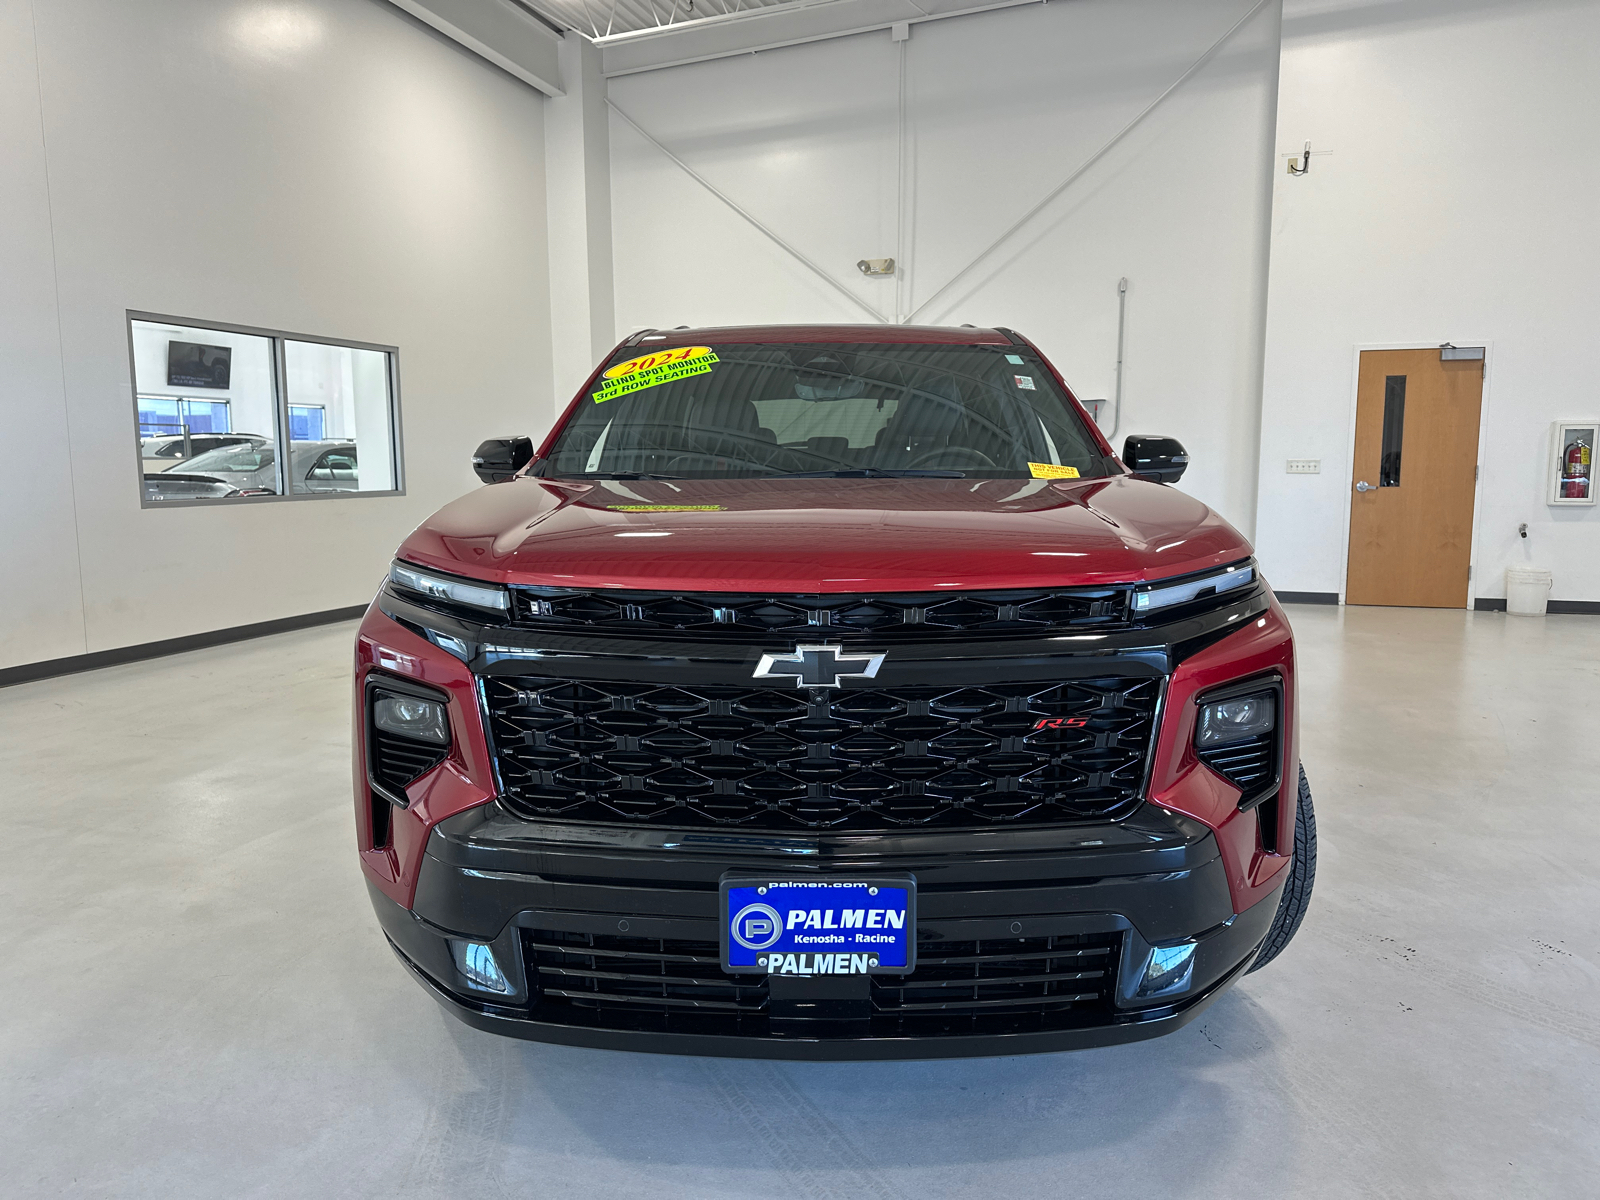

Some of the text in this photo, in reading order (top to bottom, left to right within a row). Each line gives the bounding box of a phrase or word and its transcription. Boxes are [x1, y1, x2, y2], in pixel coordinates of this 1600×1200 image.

[604, 354, 717, 389] BLIND SPOT MONITOR
[621, 348, 692, 376] 2024
[596, 364, 708, 401] 3rd ROW SEATING
[1035, 717, 1088, 729] RS
[786, 909, 906, 929] PALMEN
[794, 934, 845, 943] Kenosha
[855, 933, 896, 943] Racine
[767, 953, 869, 974] PALMEN
